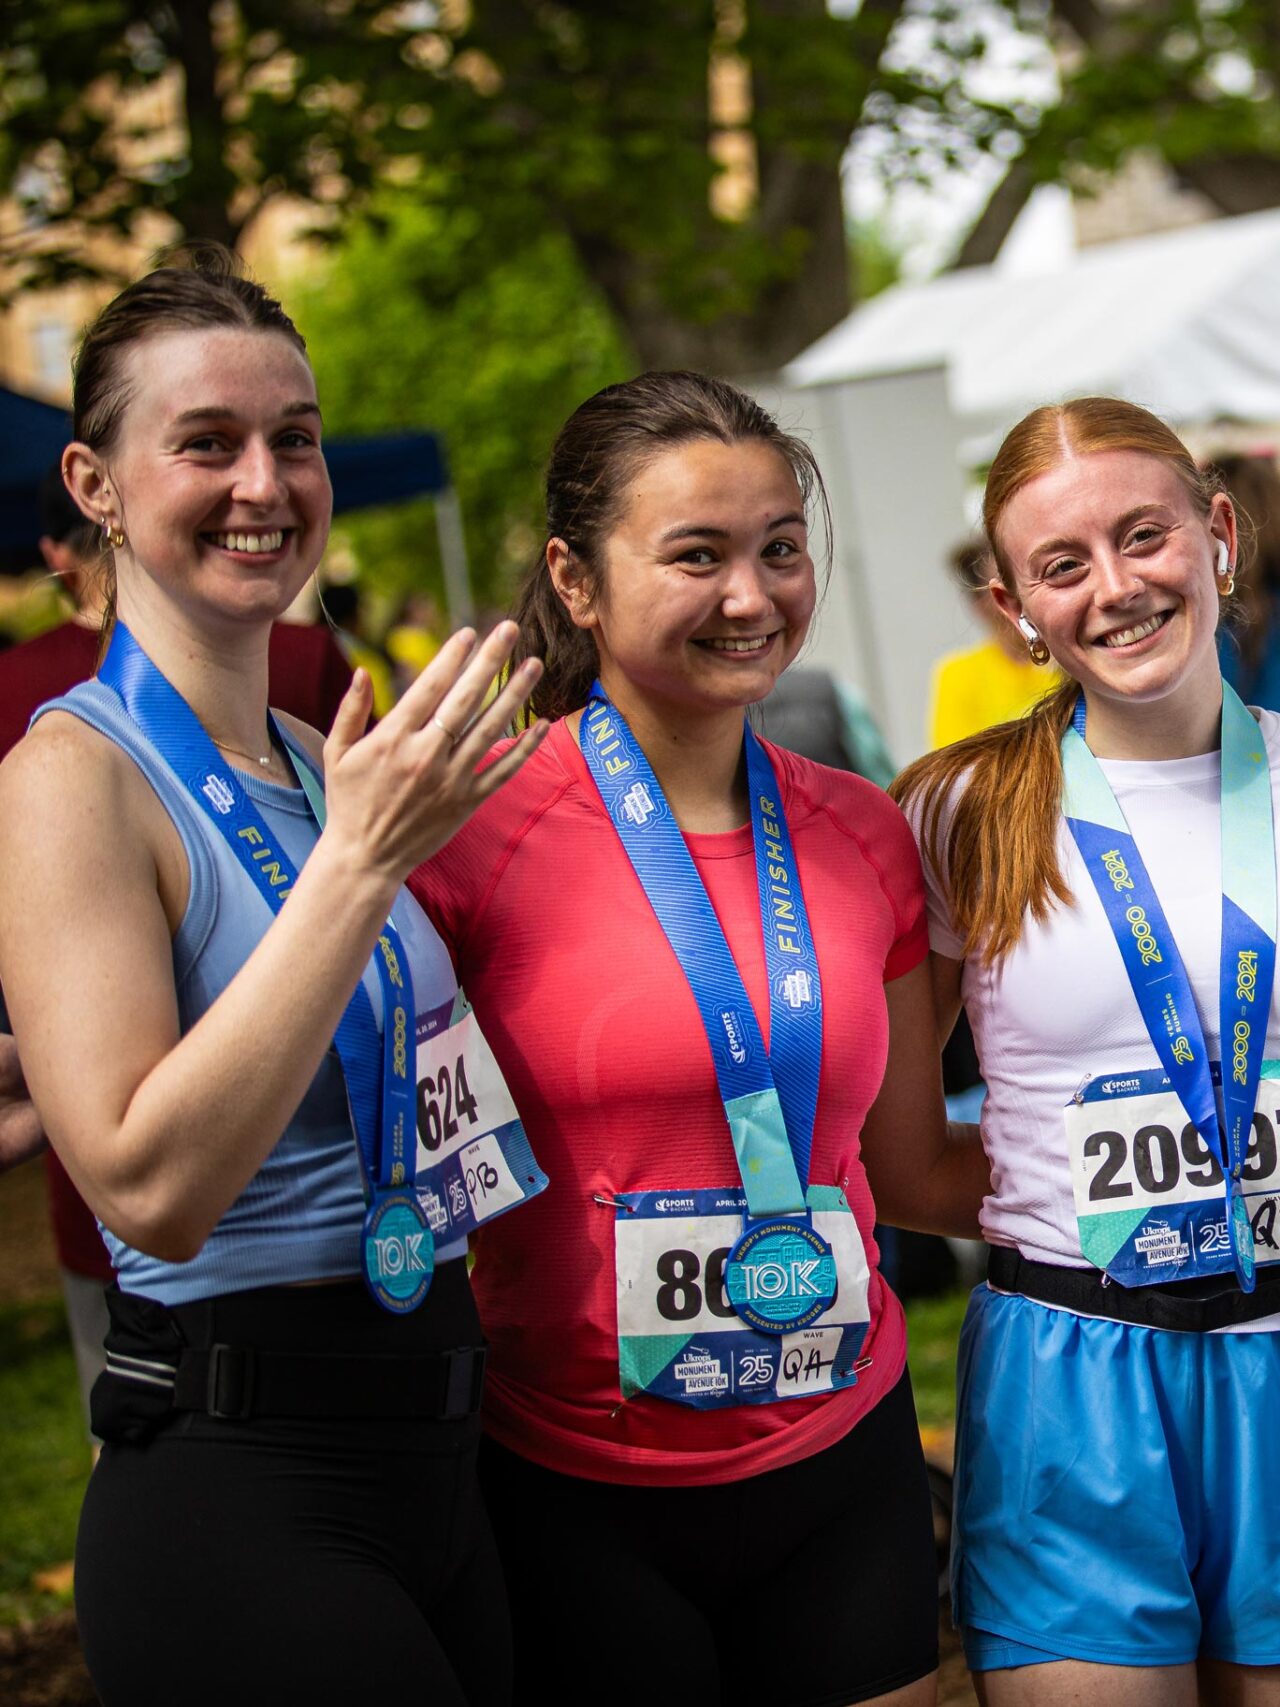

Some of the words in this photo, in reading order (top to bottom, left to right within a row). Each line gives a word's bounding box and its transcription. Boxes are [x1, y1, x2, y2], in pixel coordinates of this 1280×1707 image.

[588, 700, 630, 776] FINI
[238, 826, 292, 899] FINI
[760, 795, 801, 955] FINISHER
[1101, 849, 1134, 892] 2024
[1126, 906, 1163, 966] 2000
[1236, 950, 1258, 1003] 2024
[722, 1012, 739, 1050] SPORTS
[1162, 1008, 1173, 1037] YEARS
[1165, 992, 1182, 1034] RUNNING
[393, 1006, 406, 1080] 2000
[1170, 1035, 1194, 1066] 25
[1233, 1021, 1250, 1087] 2000
[416, 1053, 479, 1152] 624
[1112, 1079, 1140, 1088] SPORTS
[449, 1179, 467, 1217] 25
[666, 1199, 694, 1207] SPORTS
[374, 1232, 426, 1277] 10K
[760, 1225, 801, 1235] MONUMENT
[802, 1231, 825, 1253] AVENUE
[1138, 1235, 1177, 1249] MONUMENT
[1150, 1249, 1176, 1260] AVENUE
[1199, 1222, 1231, 1253] 25
[741, 1260, 822, 1300] 10K
[745, 1310, 783, 1330] PRESENTED
[797, 1304, 822, 1326] KROGER
[677, 1364, 717, 1376] MONUMENT
[688, 1377, 715, 1389] AVENUE
[715, 1377, 726, 1387] 10K
[739, 1355, 774, 1386] 25
[783, 1348, 833, 1382] QA
